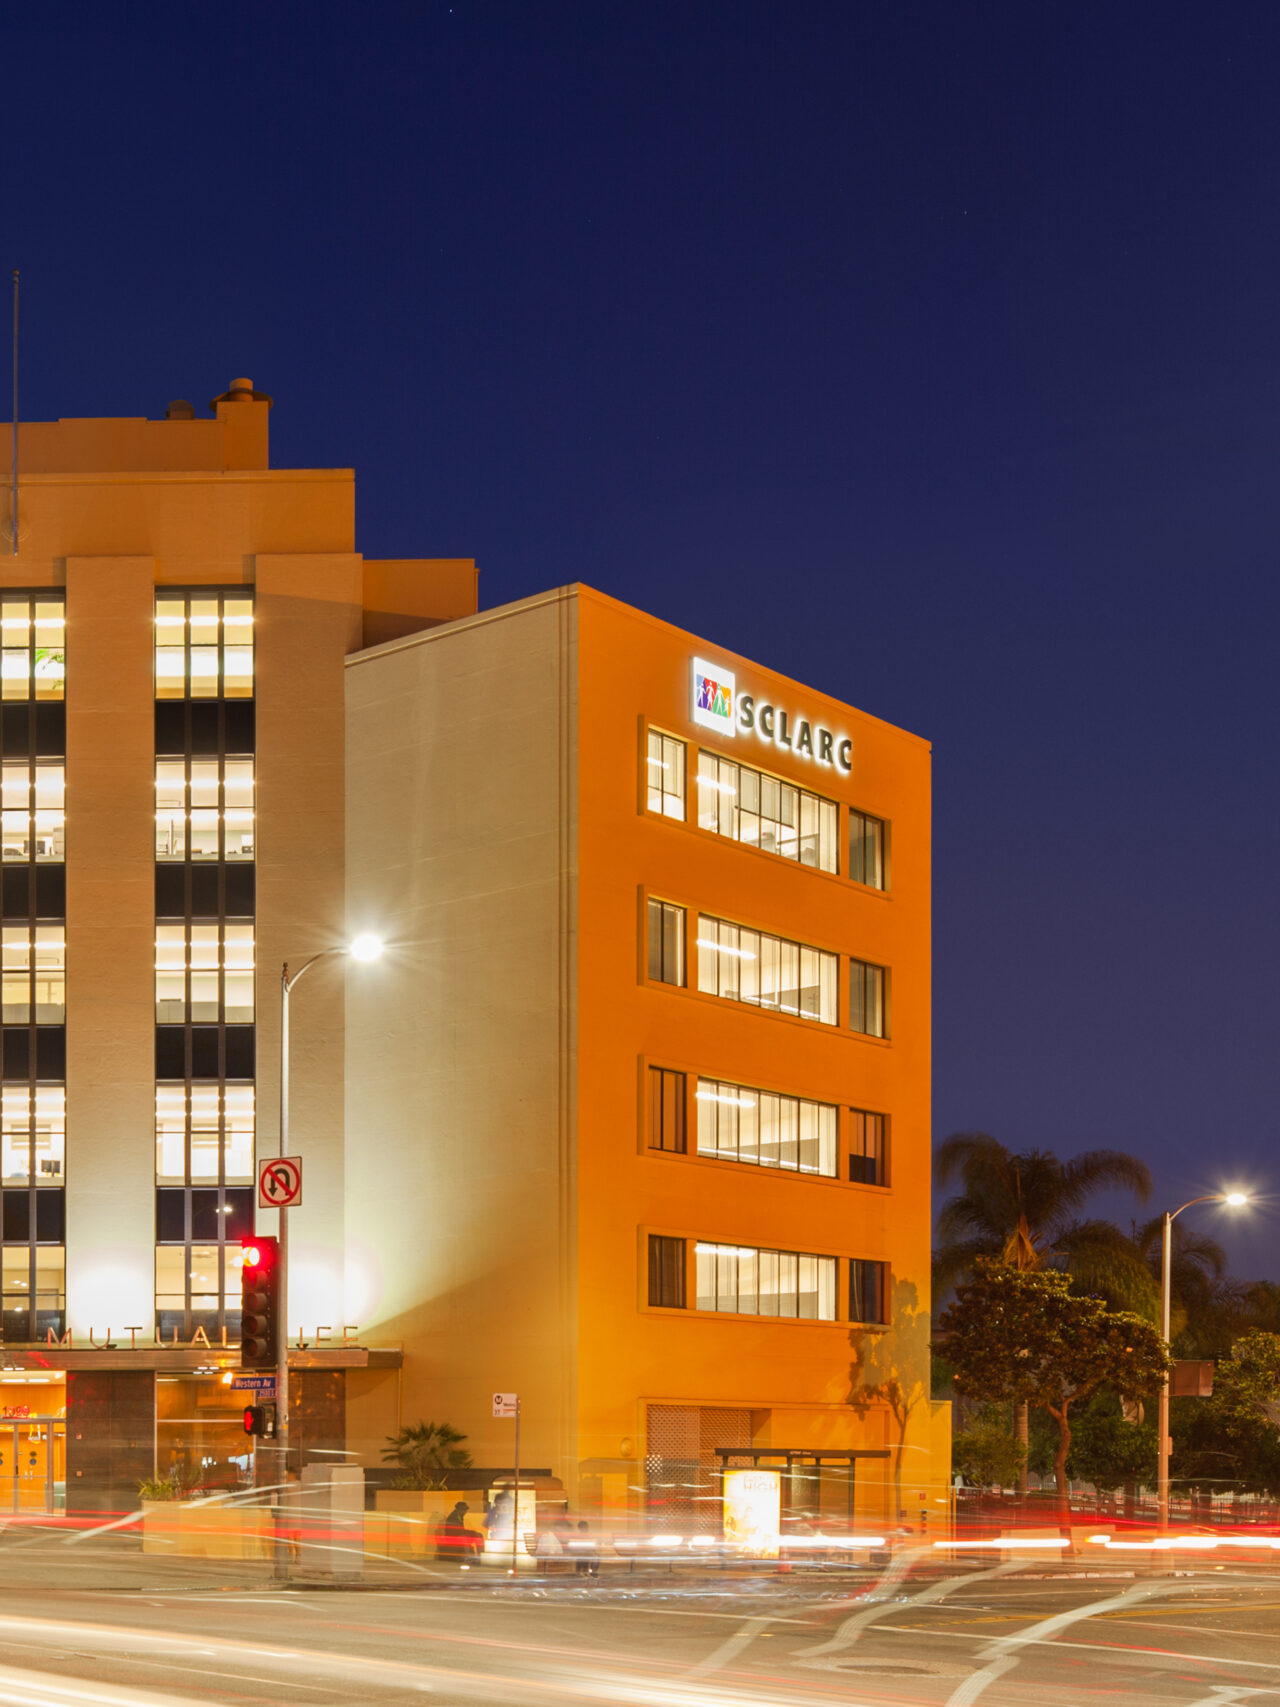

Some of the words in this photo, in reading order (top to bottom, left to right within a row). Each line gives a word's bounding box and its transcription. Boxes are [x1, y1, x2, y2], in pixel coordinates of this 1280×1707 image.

[739, 695, 853, 771] SCLARC
[47, 1326, 240, 1350] MUTUAL
[287, 1326, 359, 1349] IFE
[235, 1379, 262, 1388] Western
[263, 1378, 272, 1388] Av
